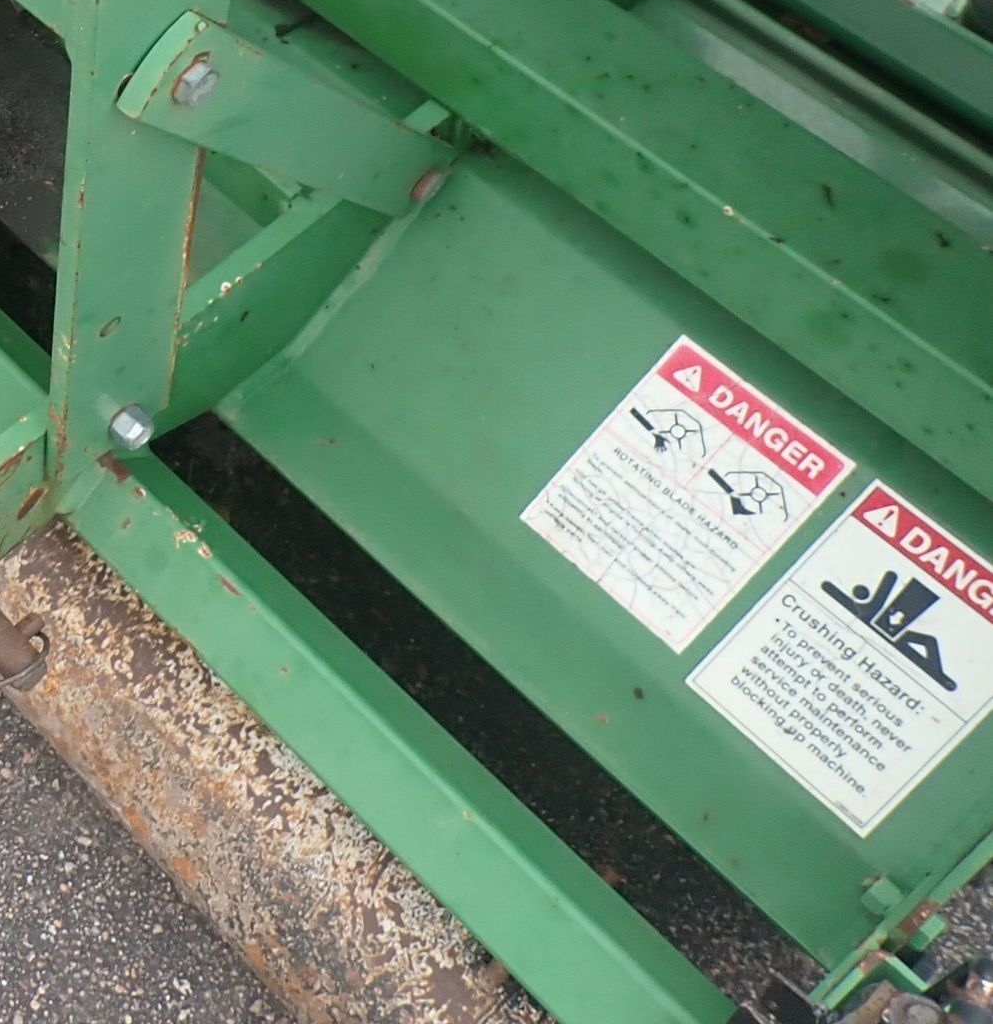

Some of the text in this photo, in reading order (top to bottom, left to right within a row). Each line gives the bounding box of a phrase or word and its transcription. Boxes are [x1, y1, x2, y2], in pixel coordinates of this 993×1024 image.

[708, 384, 825, 480] DANGER
[613, 447, 738, 549] ROTATING BLADE HAZARD
[899, 526, 993, 616] DANG
[760, 645, 882, 749] attempt to perform
[770, 633, 911, 751] injury or death, never
[781, 594, 924, 714] Crushing Hazard:
[782, 621, 903, 726] To prevent serious
[730, 675, 867, 798] blocking up machine.
[741, 666, 846, 758] without properly
[750, 655, 885, 771] service maintenance
